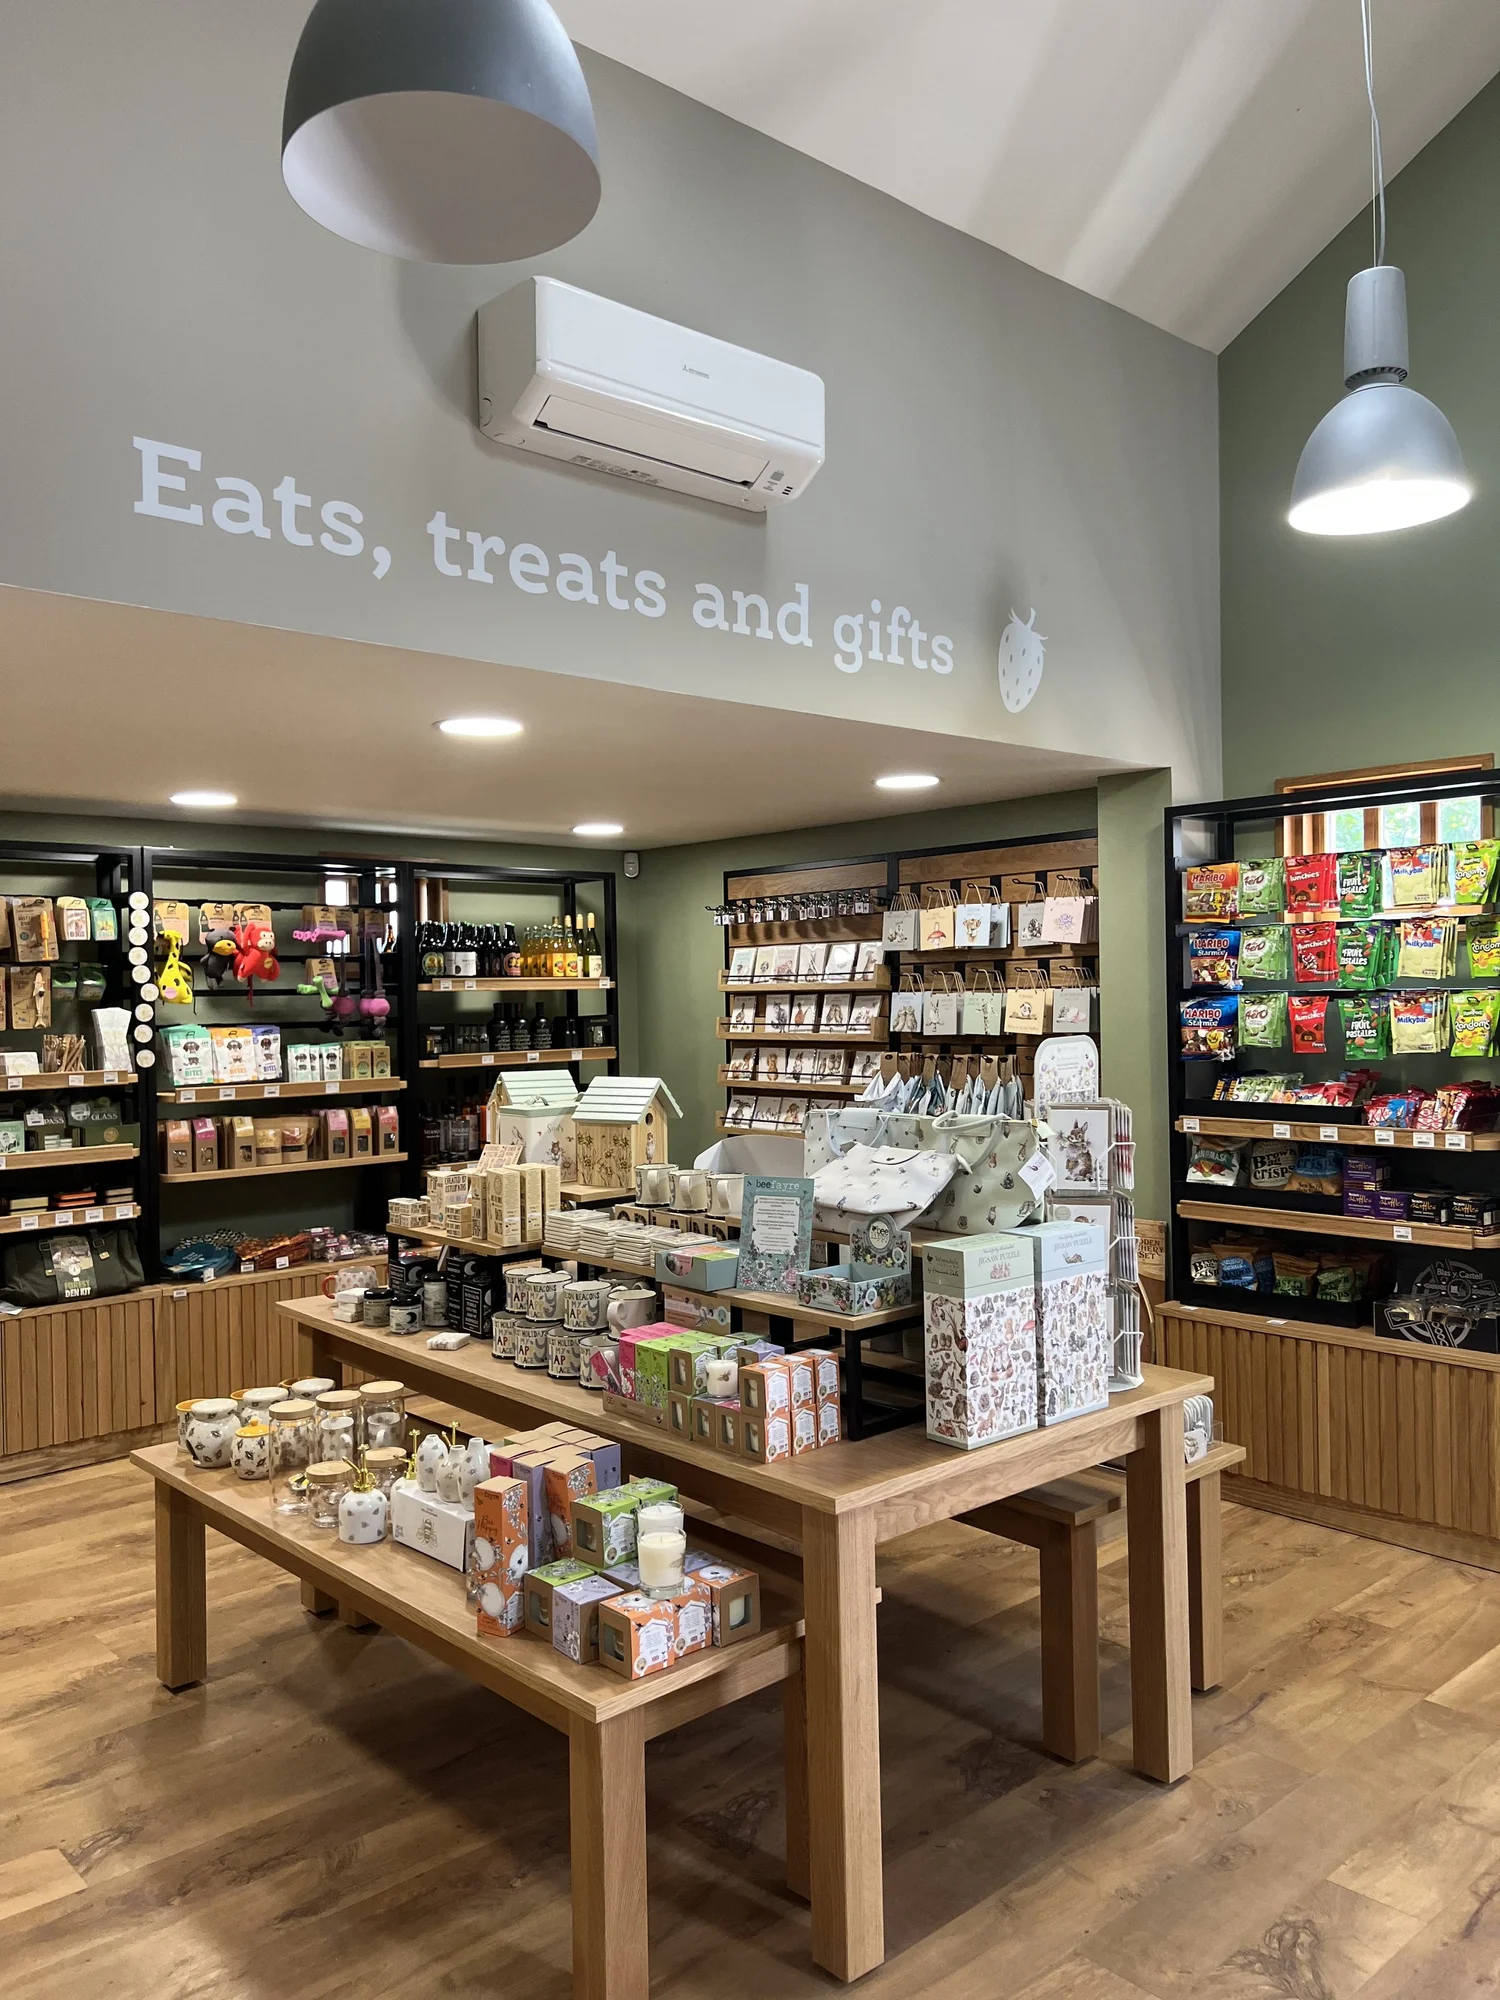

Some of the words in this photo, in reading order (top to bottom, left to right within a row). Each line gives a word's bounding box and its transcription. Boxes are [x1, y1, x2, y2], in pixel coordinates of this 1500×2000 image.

[132, 435, 392, 580] Eats,
[426, 509, 667, 618] treats
[692, 584, 813, 648] and
[833, 606, 955, 675] gifts
[1393, 867, 1424, 876] Milkybar
[1192, 873, 1226, 883] HARIBO
[1194, 938, 1229, 949] HARIBO
[1184, 1008, 1222, 1019] HARIBO
[1245, 1009, 1268, 1020] Aero
[1397, 1016, 1428, 1024] Milkybar
[1455, 1018, 1490, 1032] Randoms
[91, 1113, 118, 1121] GLASS
[756, 1179, 800, 1192] beefayre
[876, 1226, 889, 1236] bee
[1053, 1241, 1073, 1252] JIGSAW
[1073, 1237, 1094, 1247] PUZZLE
[977, 1254, 998, 1266] JIGSAW
[999, 1250, 1021, 1261] PUZZLE
[1437, 1268, 1451, 1277] Blas
[65, 1288, 80, 1298] DEN
[80, 1286, 92, 1296] KIT
[533, 1284, 557, 1293] BEACONS
[575, 1291, 600, 1300] BEACONS
[482, 1514, 494, 1525] Bee
